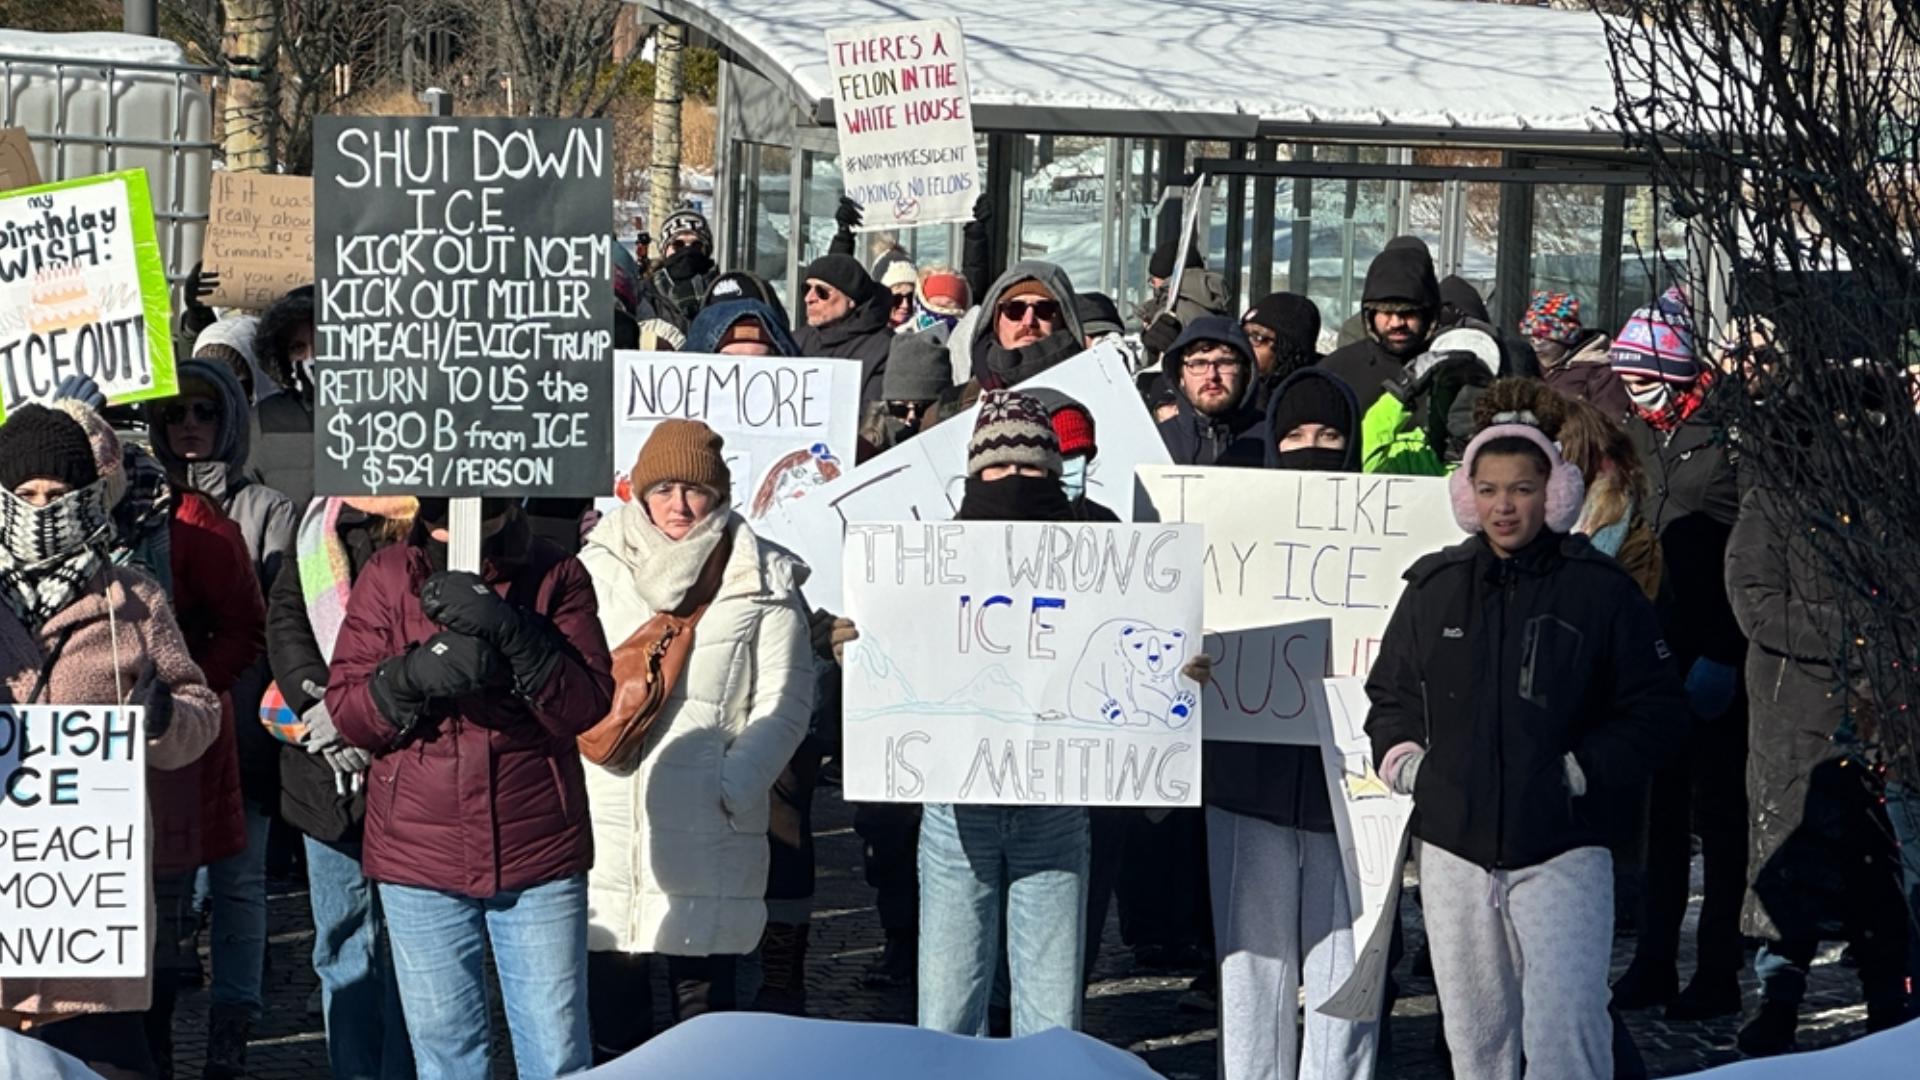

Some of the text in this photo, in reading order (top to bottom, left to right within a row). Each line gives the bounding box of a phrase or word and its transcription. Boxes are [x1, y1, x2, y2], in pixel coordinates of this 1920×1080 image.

[932, 32, 949, 58] A
[838, 63, 958, 102] FELON IN THE
[844, 97, 965, 135] WHITE HOUSE
[335, 126, 602, 187] SHUT DOWN
[27, 194, 54, 209] my
[219, 176, 234, 203] If
[242, 179, 258, 203] it
[928, 172, 972, 196] FELONS
[217, 206, 262, 232] really
[404, 187, 515, 235] I.C.E.
[243, 271, 273, 283] you
[336, 234, 611, 279] KICK OUT NOEM
[321, 277, 591, 321] KICK OUT MILLER
[316, 318, 611, 370] IMPEACH/EVICT TRUMP
[319, 365, 589, 406] RETURN TO US the
[326, 407, 590, 469] $180 B from ICE
[362, 449, 434, 495] $529
[1296, 476, 1415, 537] LIKE
[848, 524, 1181, 595] THE WRONG
[1272, 541, 1390, 610] I.C.E.
[958, 595, 1067, 660] ICE
[885, 730, 931, 798] IS
